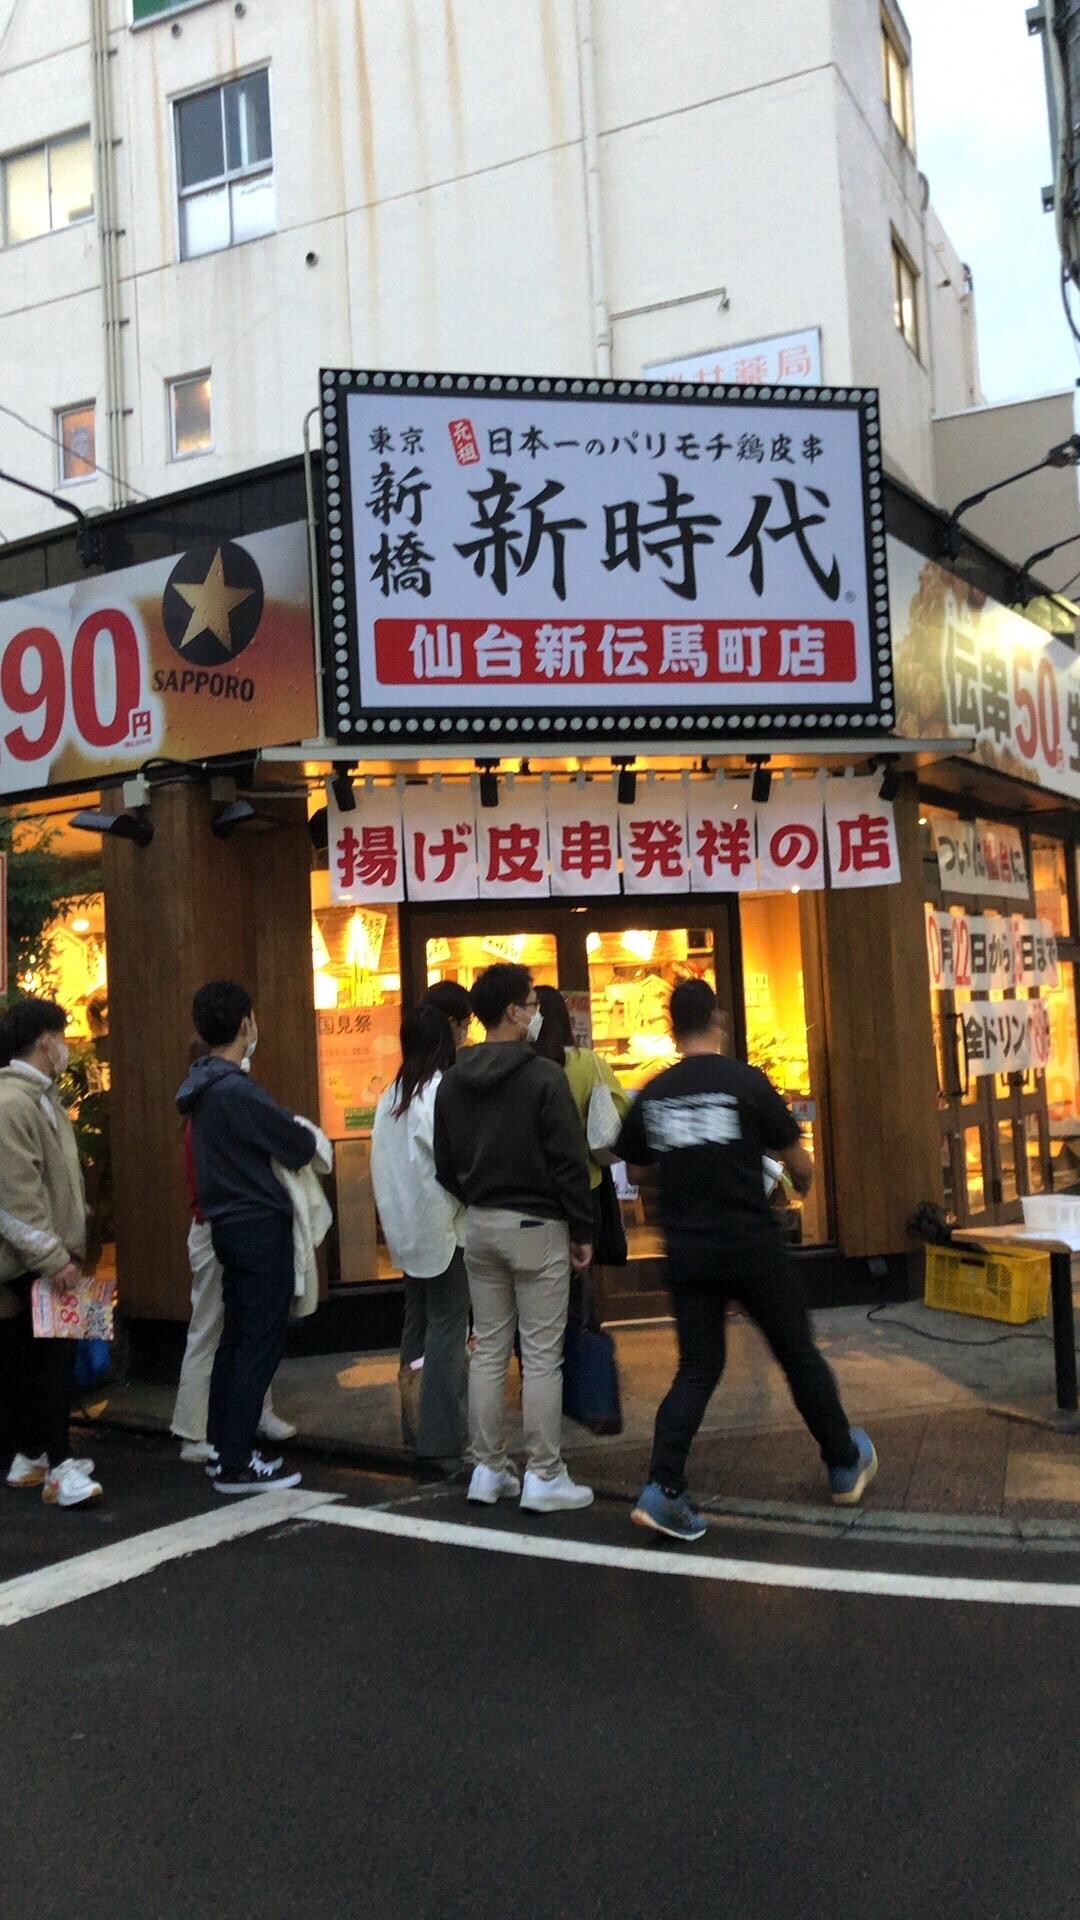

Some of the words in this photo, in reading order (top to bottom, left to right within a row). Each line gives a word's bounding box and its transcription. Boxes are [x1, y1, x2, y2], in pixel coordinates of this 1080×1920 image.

[369, 426, 424, 454] 東京
[449, 421, 479, 465] 元祖
[487, 425, 824, 464] 日本一のパリモチ鶏皮串
[365, 462, 436, 598] 新橋
[454, 468, 841, 601] 新時代
[409, 622, 826, 679] 仙台新伝馬町店
[153, 669, 255, 703] SAPPORO
[336, 813, 890, 888] 揚げ皮串発祥の店
